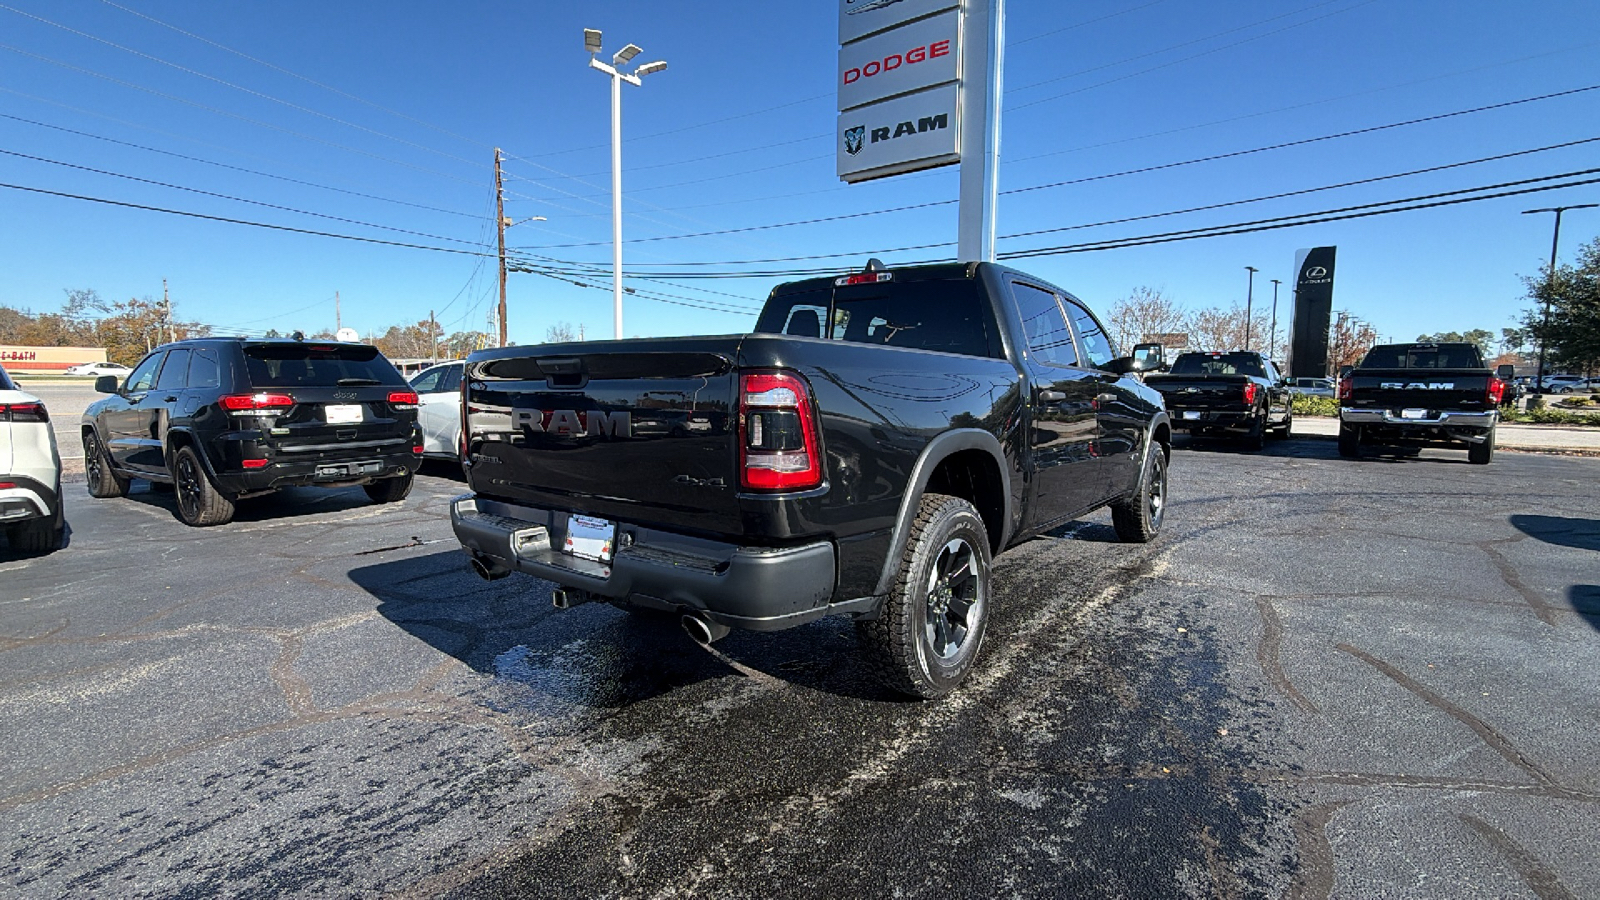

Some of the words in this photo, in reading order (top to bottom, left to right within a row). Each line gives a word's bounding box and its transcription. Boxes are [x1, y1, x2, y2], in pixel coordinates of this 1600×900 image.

[844, 39, 950, 85] DODGE
[870, 113, 948, 143] RAM
[1381, 382, 1454, 390] RAM
[512, 408, 632, 437] RAM
